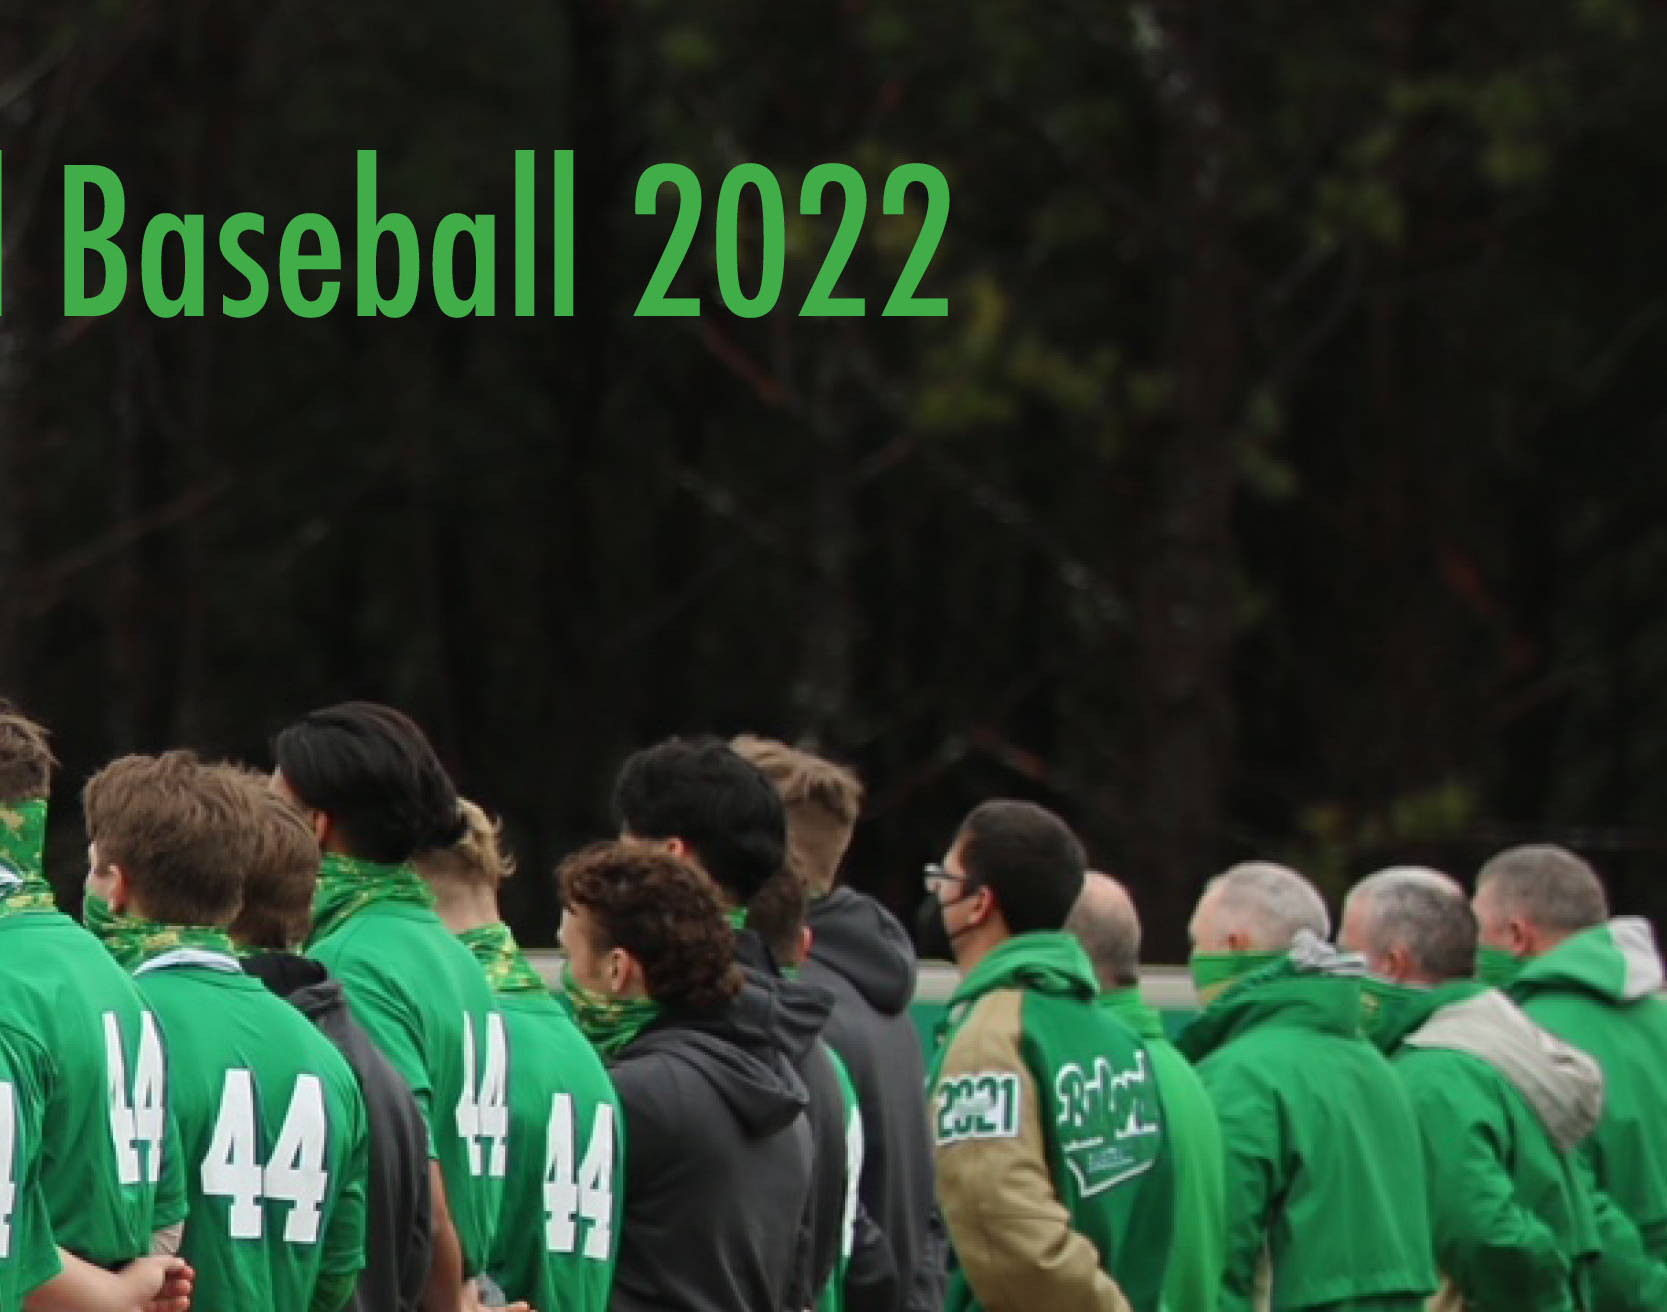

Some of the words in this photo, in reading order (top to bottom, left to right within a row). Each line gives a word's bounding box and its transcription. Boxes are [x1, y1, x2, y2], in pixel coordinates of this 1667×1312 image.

[102, 1010, 165, 1184] 44
[200, 1068, 328, 1243] 44
[455, 1010, 509, 1177] 44
[543, 1092, 613, 1261] 44
[937, 1076, 1018, 1140] 2021
